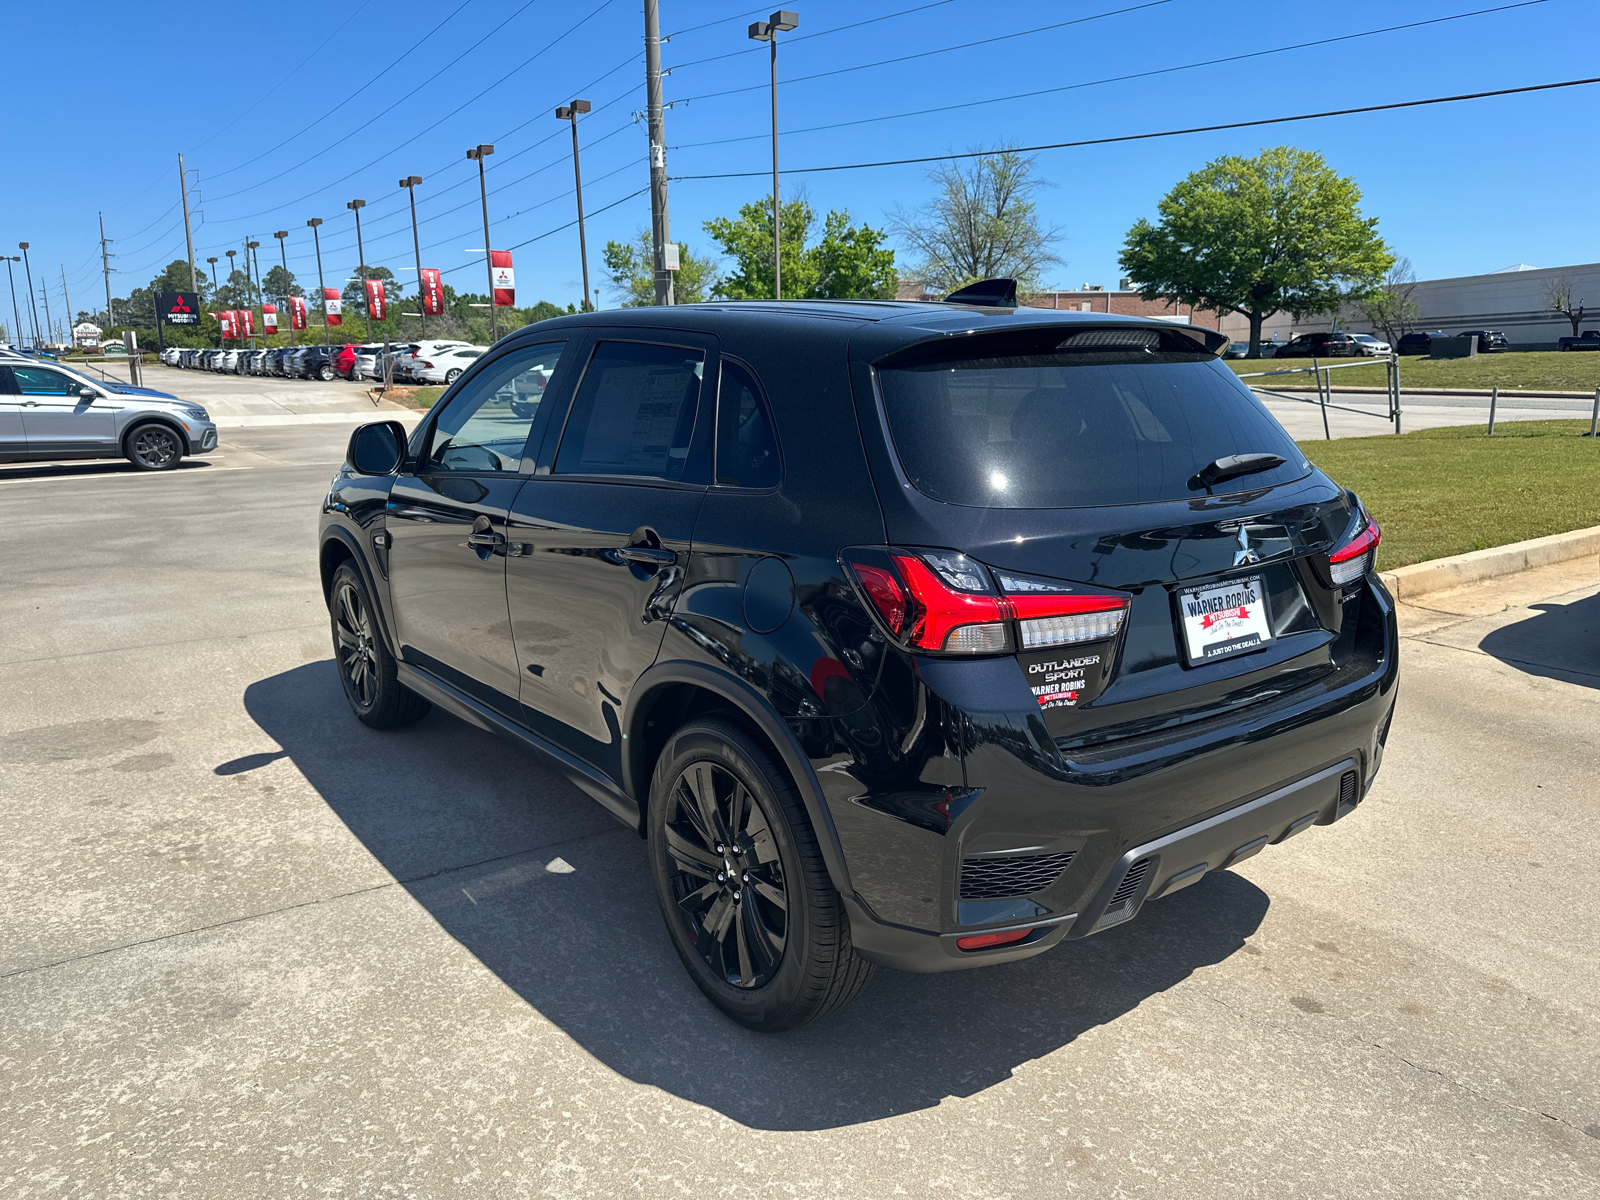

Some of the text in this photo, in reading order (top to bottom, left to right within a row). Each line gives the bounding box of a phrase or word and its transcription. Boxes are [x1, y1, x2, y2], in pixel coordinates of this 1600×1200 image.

[1187, 590, 1256, 618] WARNER ROBINS
[1209, 608, 1240, 622] MITSUBISHI
[1212, 648, 1224, 656] JUST
[1028, 655, 1100, 674] OUTLANDER
[1045, 668, 1086, 682] SPORT
[1060, 680, 1086, 692] ROBINS
